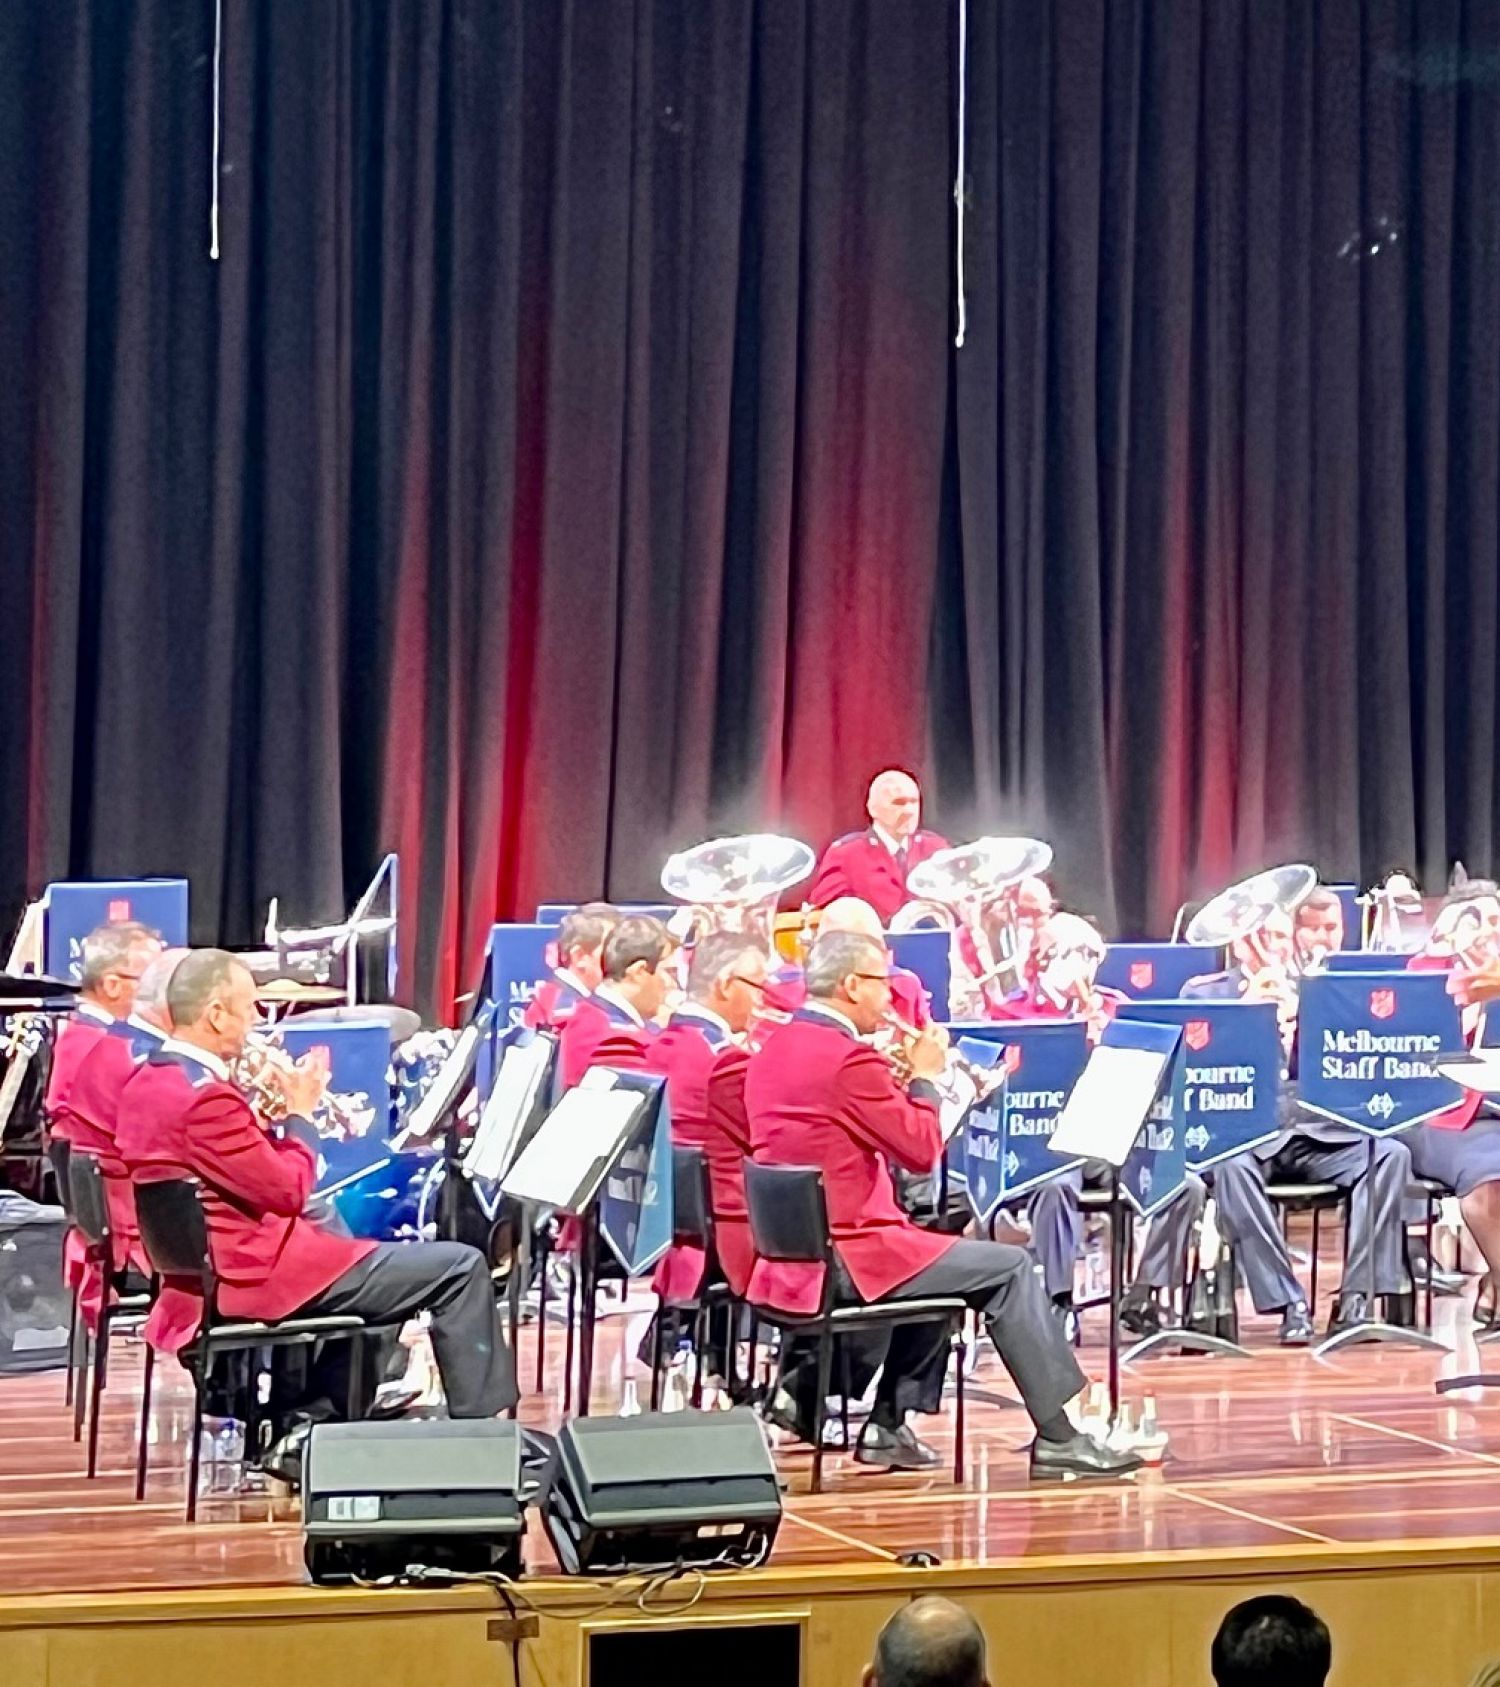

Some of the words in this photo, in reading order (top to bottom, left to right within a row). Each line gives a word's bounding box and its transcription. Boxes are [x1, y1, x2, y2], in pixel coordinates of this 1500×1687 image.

[1322, 1029, 1441, 1053] Melbourne
[1322, 1056, 1379, 1080] Staff
[1199, 1086, 1254, 1111] Band
